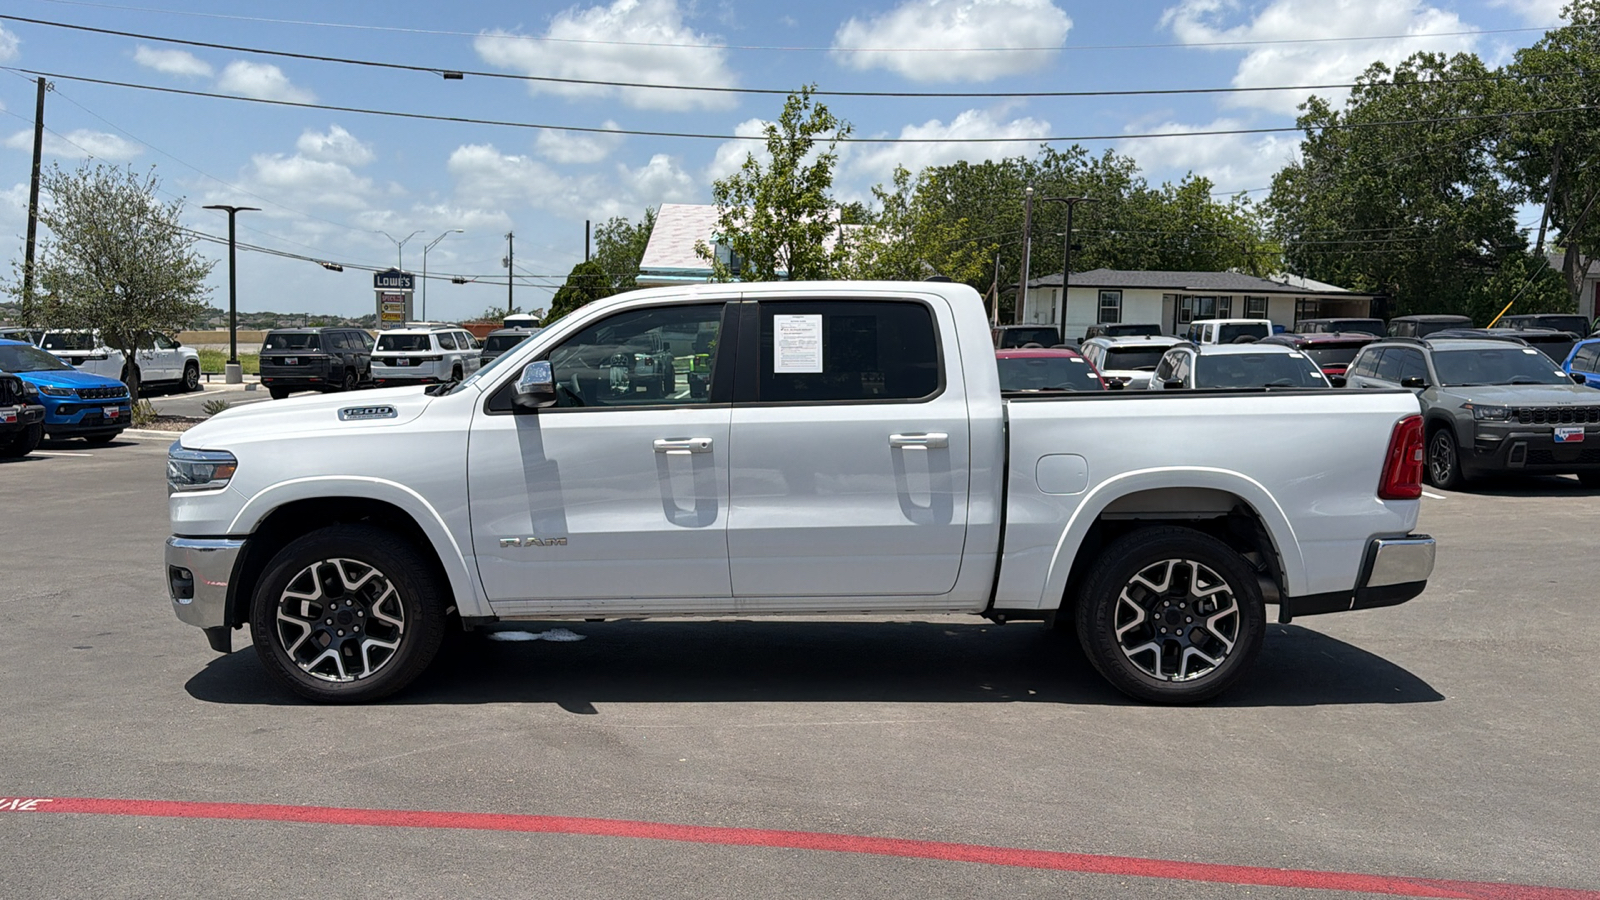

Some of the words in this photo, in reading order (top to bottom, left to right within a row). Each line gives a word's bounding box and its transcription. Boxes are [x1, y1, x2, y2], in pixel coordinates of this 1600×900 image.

[378, 276, 410, 287] LOWE'S
[345, 407, 389, 416] 1500
[499, 537, 567, 548] RAM
